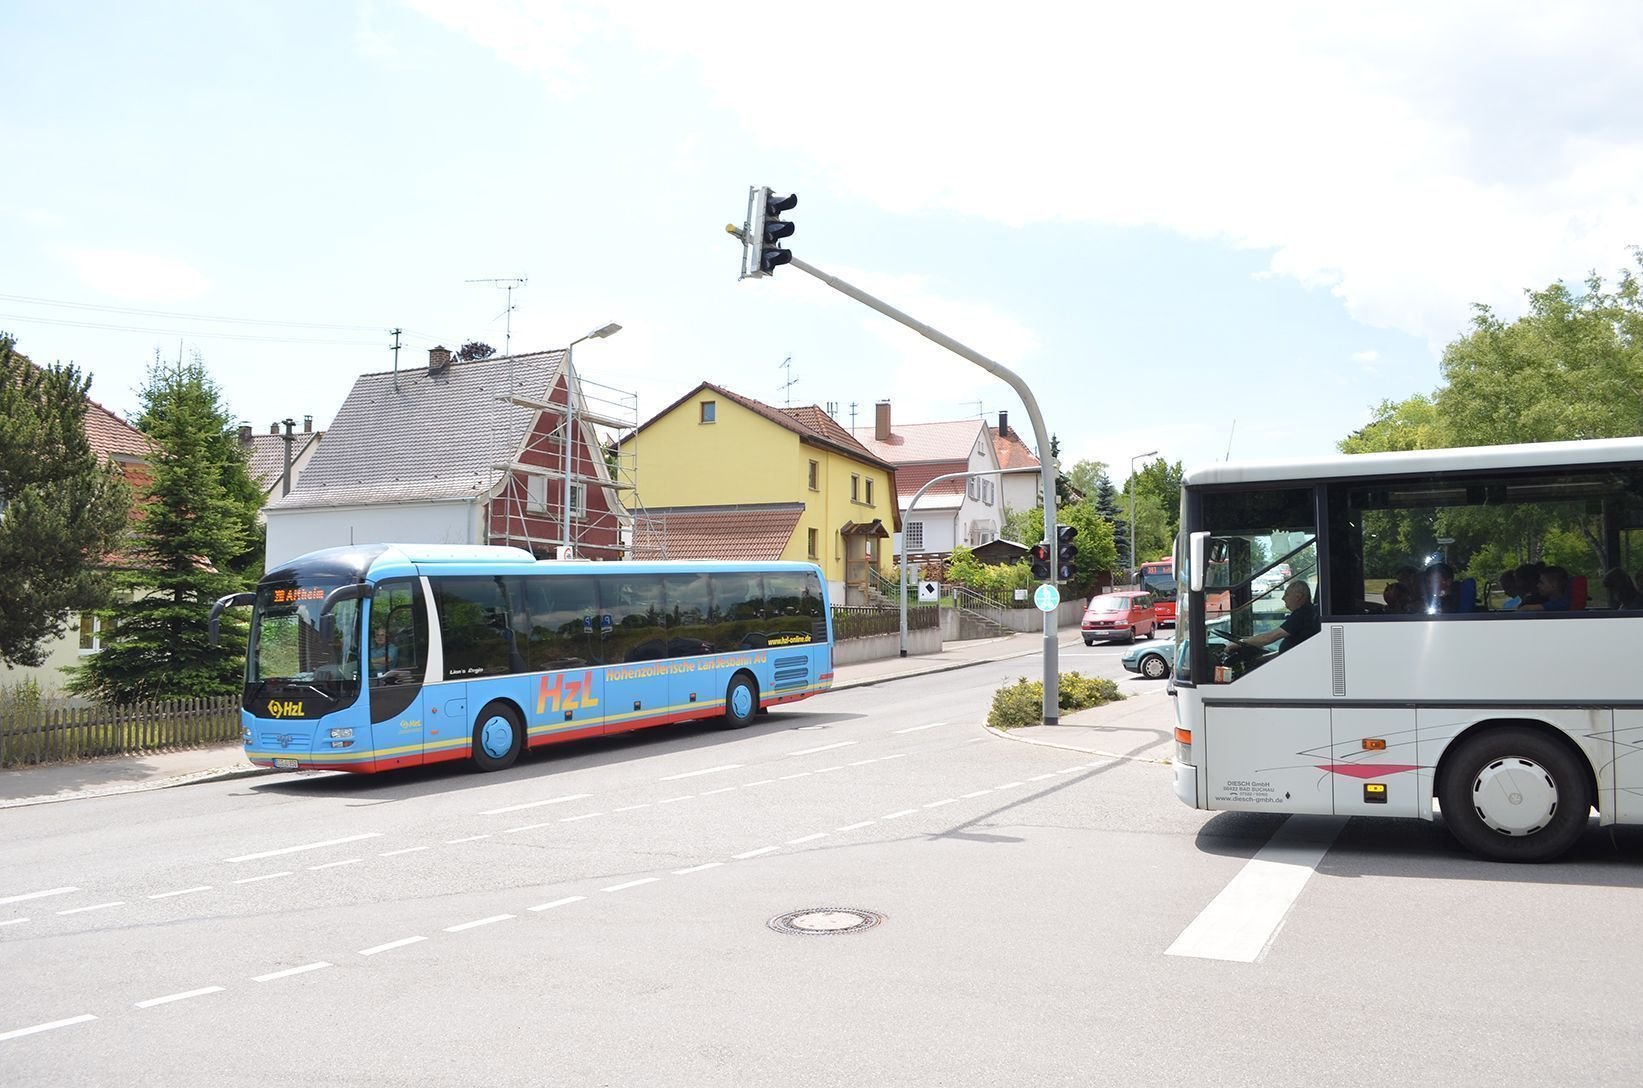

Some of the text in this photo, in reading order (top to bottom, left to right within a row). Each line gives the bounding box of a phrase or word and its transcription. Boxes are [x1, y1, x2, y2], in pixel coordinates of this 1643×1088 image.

[286, 588, 324, 600] Altheim
[605, 651, 767, 682] Hohenzollerische Landesbahn AG
[535, 670, 599, 714] HzL
[283, 701, 305, 716] HzL
